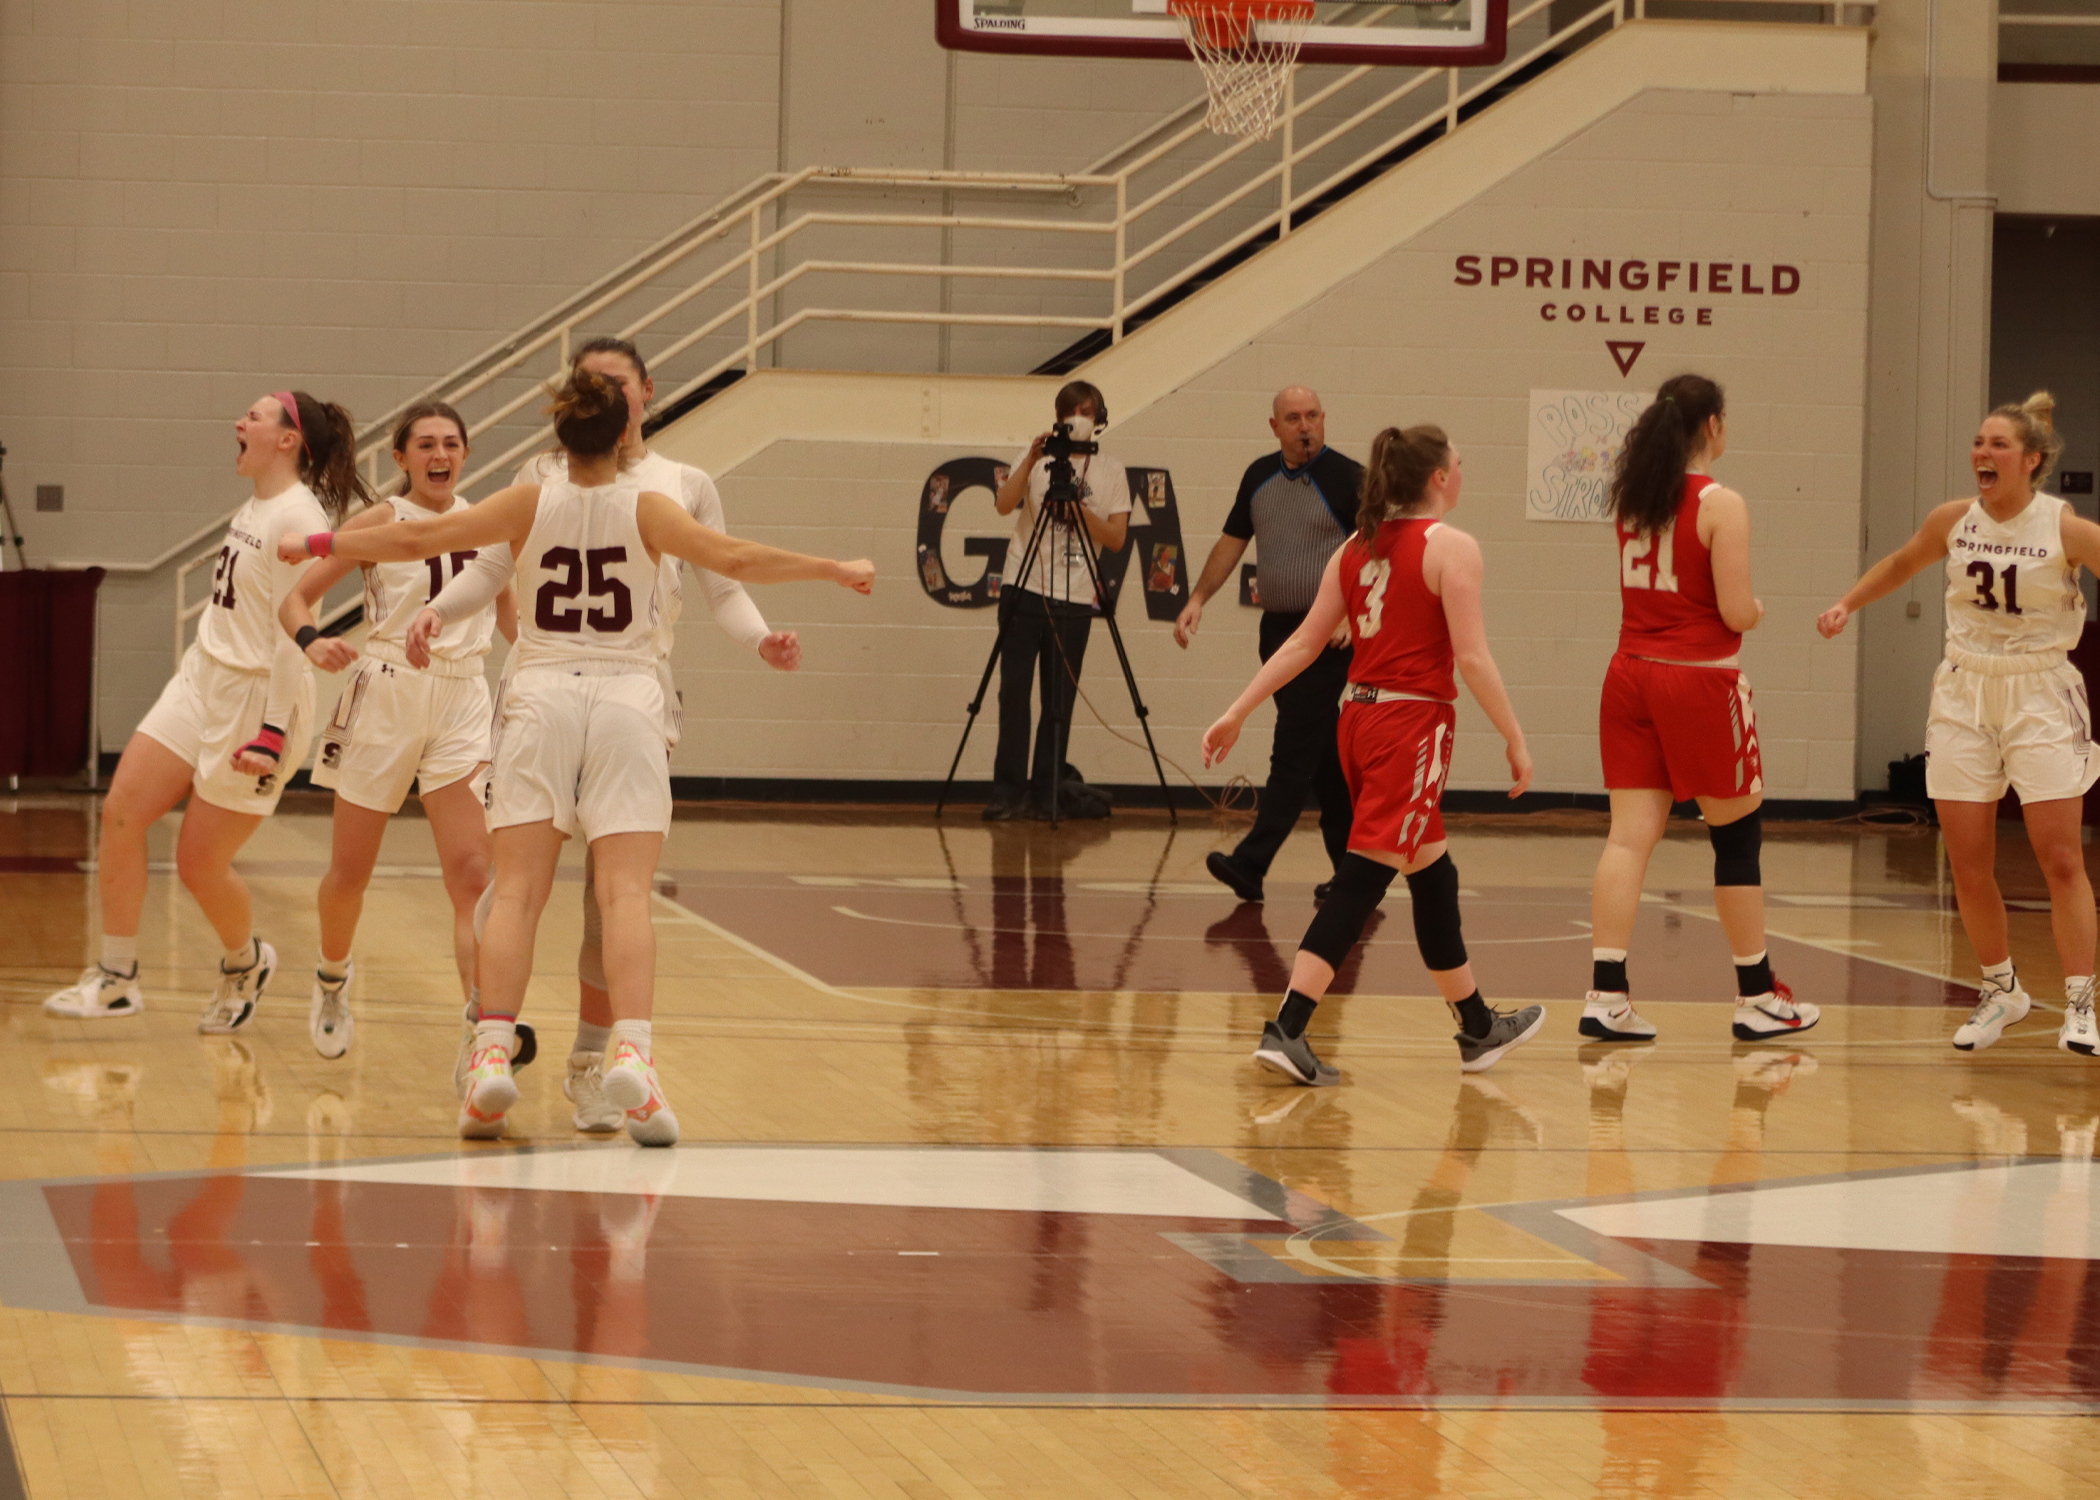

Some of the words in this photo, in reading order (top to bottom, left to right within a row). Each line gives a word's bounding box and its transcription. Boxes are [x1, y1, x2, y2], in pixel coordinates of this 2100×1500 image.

[973, 17, 1026, 30] SPALDING
[1453, 254, 1801, 296] SPRINGFIELD
[1540, 303, 1713, 326] COLLEGE
[1622, 515, 1679, 593] 21
[1956, 538, 2047, 558] SPRINGFIELD
[212, 545, 239, 610] 21
[535, 545, 633, 634] 25
[1356, 558, 1392, 639] 3
[1966, 560, 2023, 616] 31
